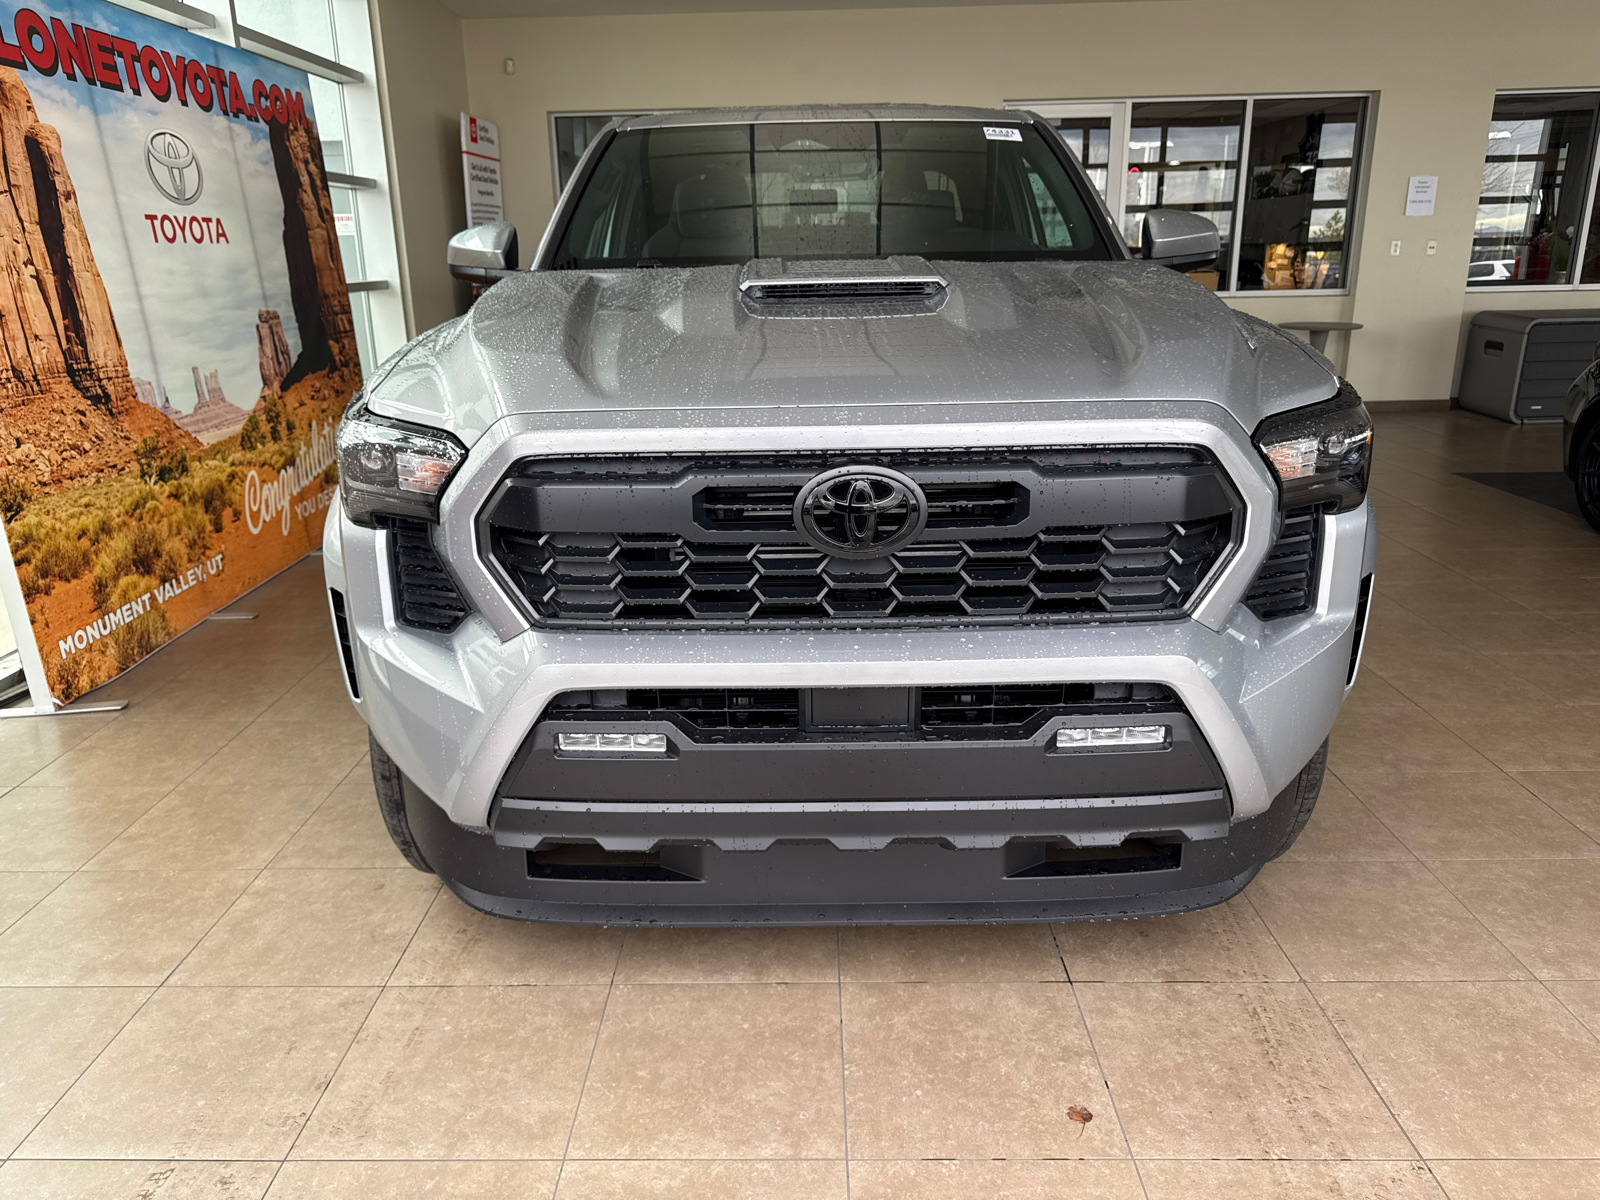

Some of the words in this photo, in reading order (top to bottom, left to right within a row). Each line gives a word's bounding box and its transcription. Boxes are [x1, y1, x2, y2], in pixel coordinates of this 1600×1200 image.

[144, 214, 230, 244] TOYOTA
[245, 416, 339, 536] Congratulati
[294, 496, 317, 520] YOU
[58, 593, 152, 659] MONUMENT
[153, 564, 207, 605] VALLEY,
[206, 554, 224, 576] UT
